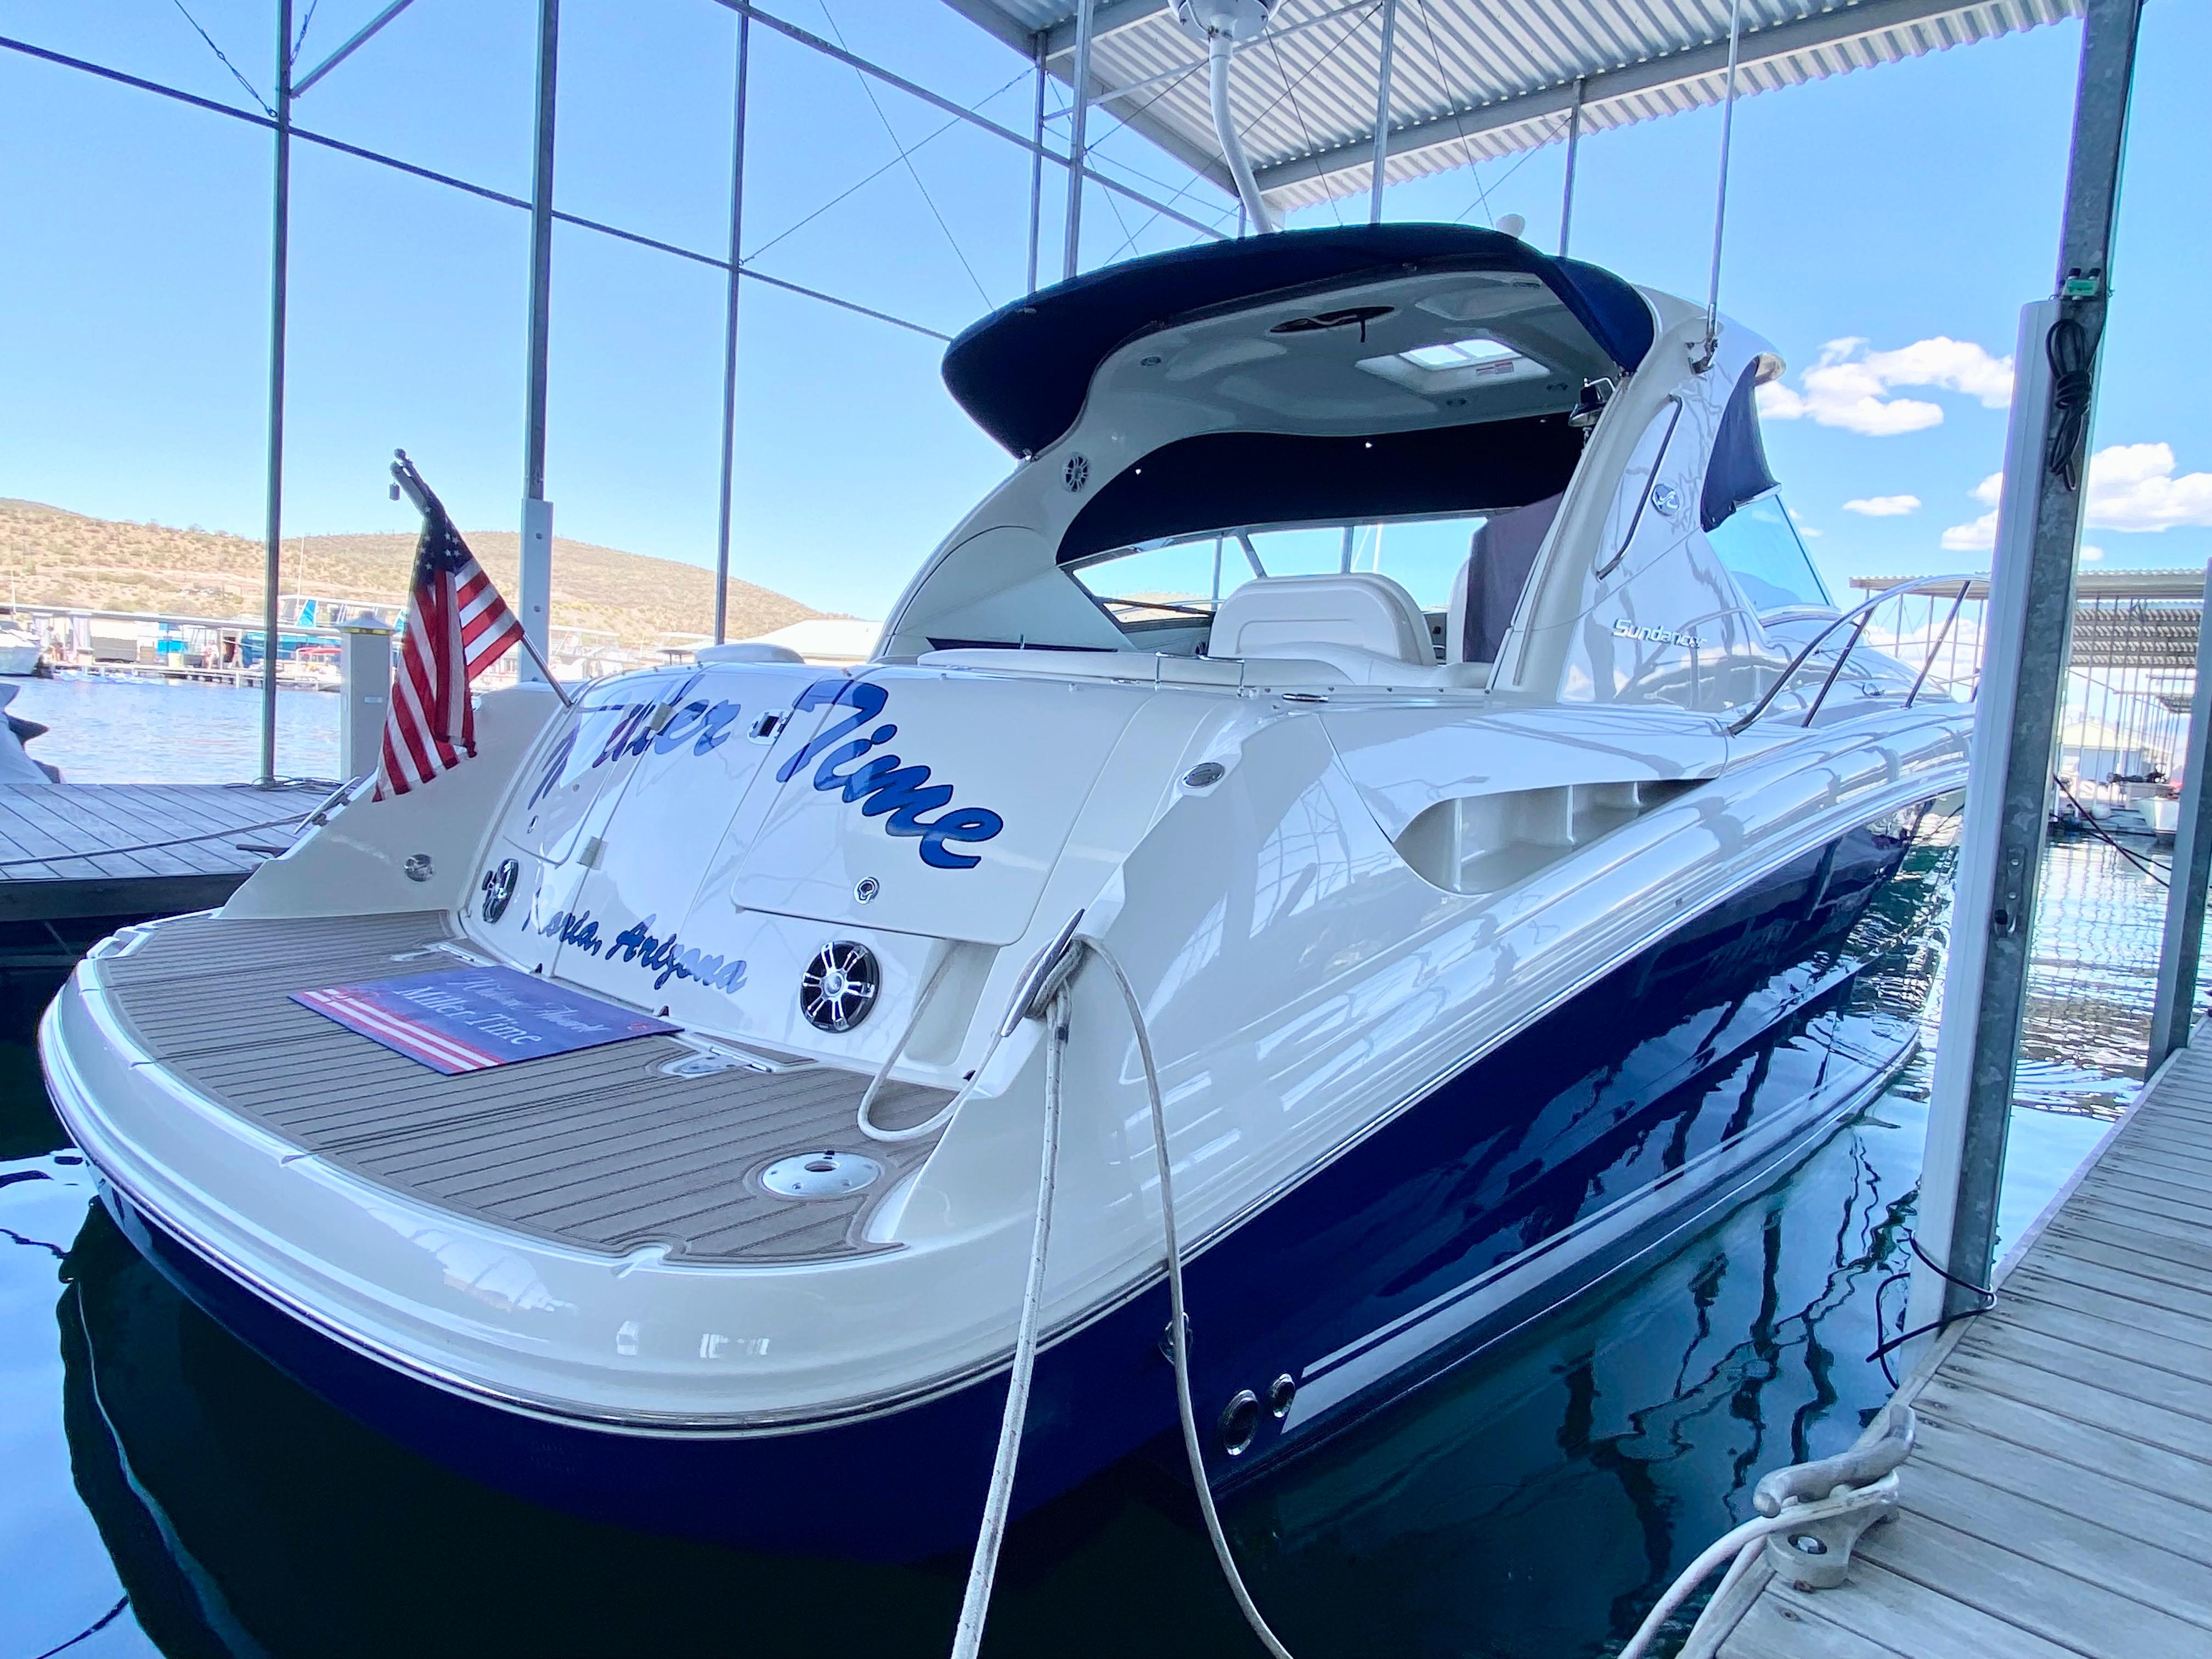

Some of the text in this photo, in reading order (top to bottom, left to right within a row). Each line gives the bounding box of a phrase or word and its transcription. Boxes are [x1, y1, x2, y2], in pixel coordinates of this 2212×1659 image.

[776, 679, 1004, 870] Time
[522, 885, 602, 957] oria,
[605, 913, 748, 994] Arizona
[392, 985, 476, 1018] Miller
[464, 1013, 543, 1045] Time
